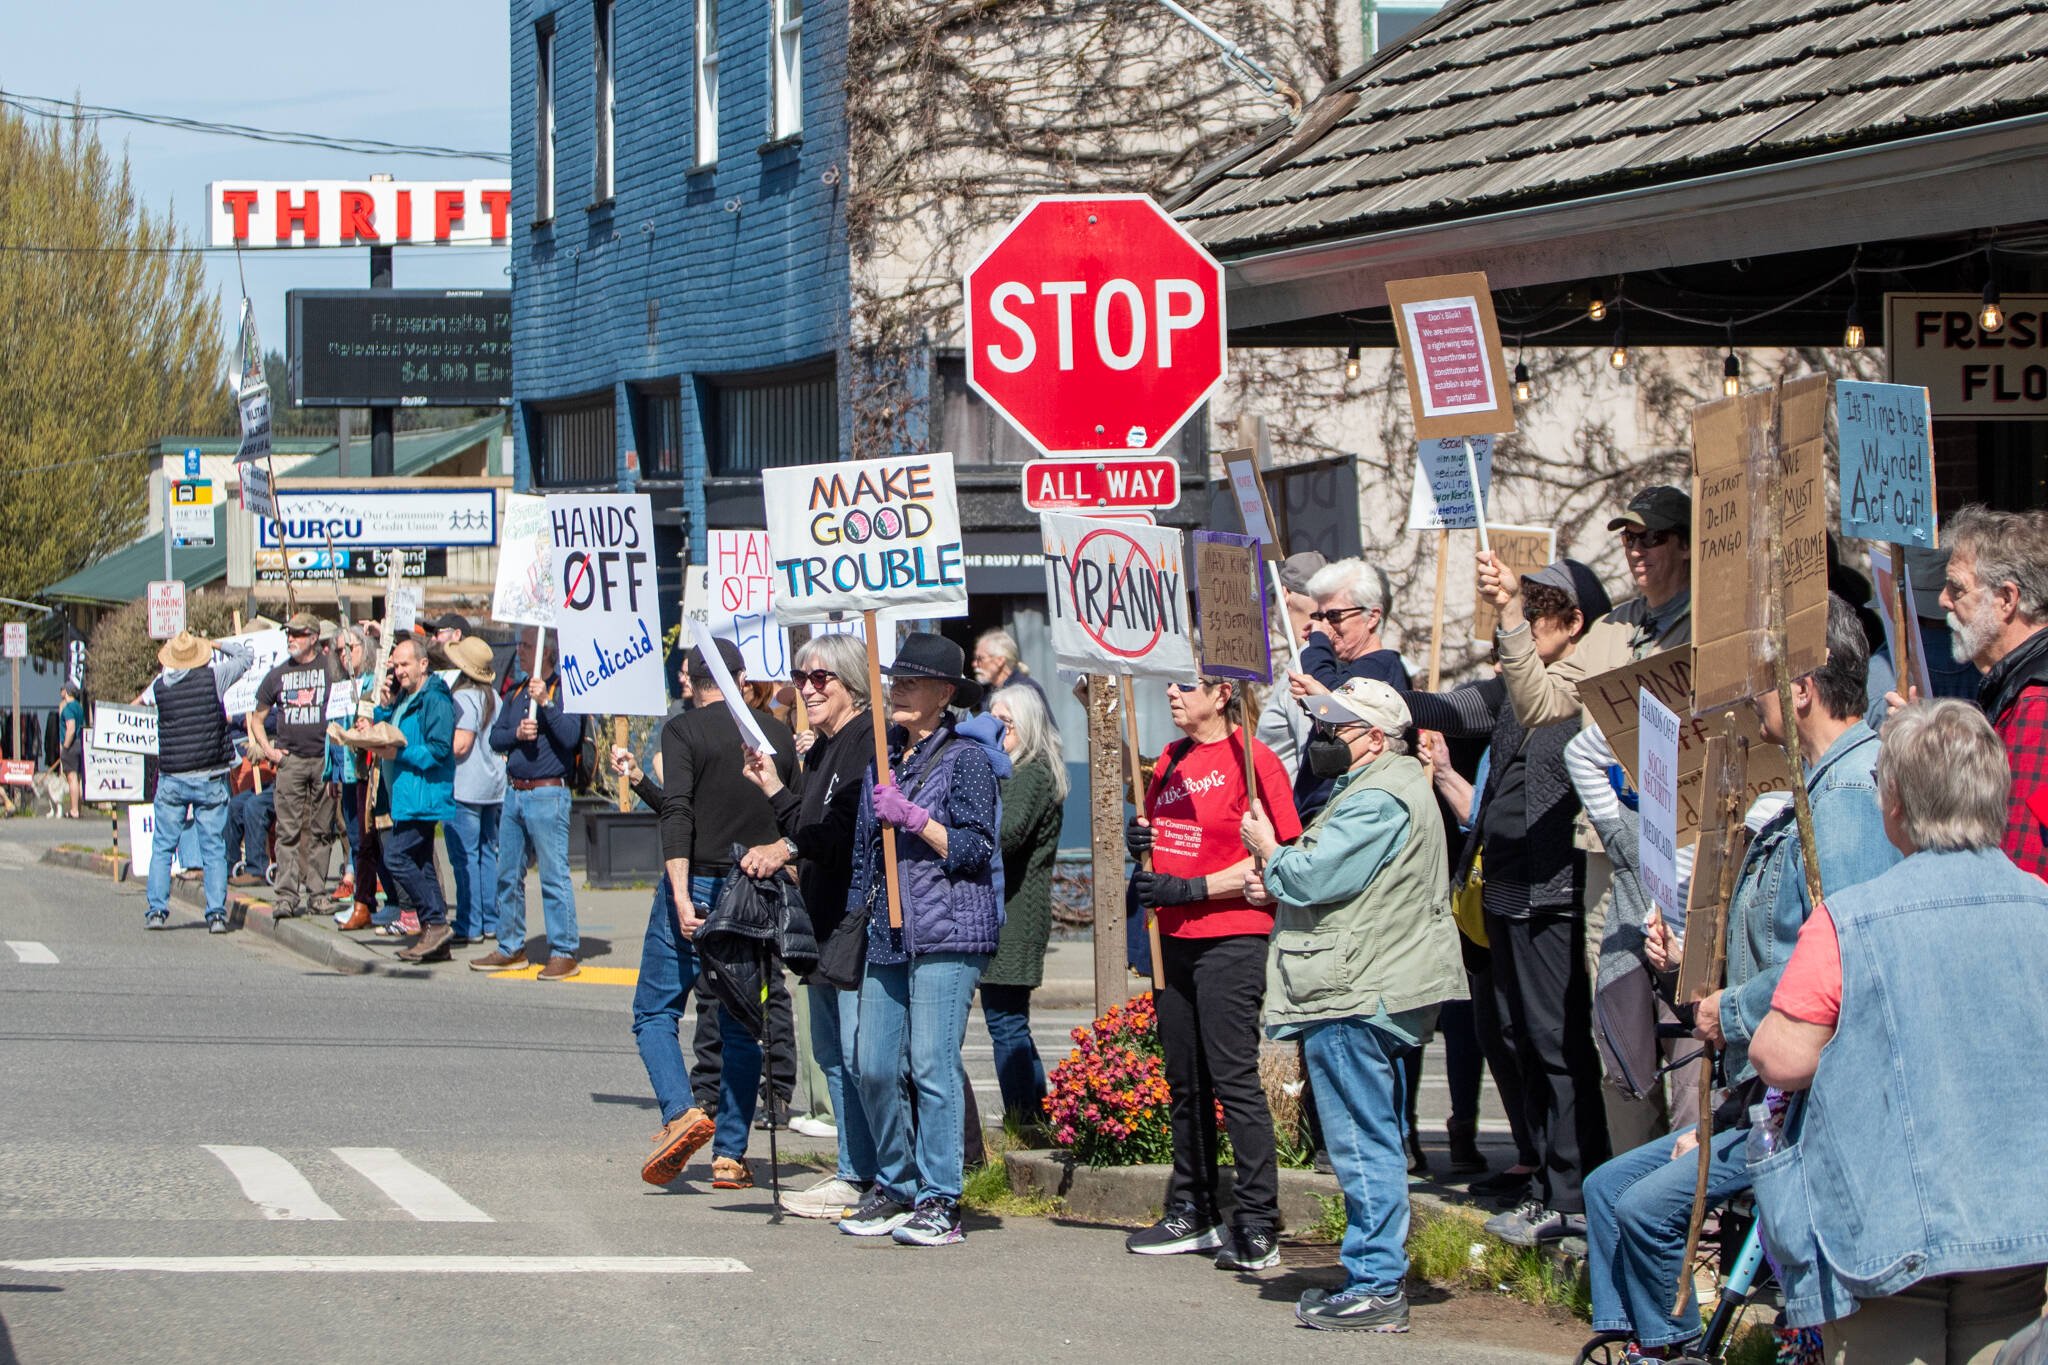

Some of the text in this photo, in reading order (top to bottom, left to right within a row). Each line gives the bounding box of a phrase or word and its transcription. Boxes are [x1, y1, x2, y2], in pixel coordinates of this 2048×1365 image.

[987, 278, 1205, 373] STOP
[1423, 328, 1433, 336] We
[1433, 328, 1444, 336] are
[1428, 313, 1444, 321] Don't
[1915, 311, 2048, 350] FRES
[1434, 365, 1479, 376] constitution and
[1437, 353, 1467, 362] overthrow
[1435, 380, 1460, 390] establish
[1446, 394, 1461, 404] party
[1962, 364, 2048, 403] FLO
[1862, 393, 1895, 436] Time
[1897, 396, 1908, 433] to
[1911, 398, 1924, 437] be
[1440, 438, 1464, 449] Social
[1861, 438, 1922, 486] Wyrde!
[1783, 450, 1800, 477] WE
[809, 464, 935, 510] MAKE
[1039, 469, 1164, 500] ALL WAY
[1783, 478, 1814, 515] MUST
[1851, 468, 1924, 527] Act Out!
[268, 510, 445, 539] OURCU Our Community
[373, 522, 438, 531] Credit Union
[551, 506, 640, 548] HANDS
[811, 502, 935, 546] GOOD
[983, 555, 1021, 566] RUBY
[1490, 533, 1548, 568] RMERS
[1701, 531, 1742, 562] TANGO
[1783, 531, 1824, 568] VERCOME
[563, 551, 647, 612] OFF
[776, 542, 963, 598] TROUBLE
[161, 588, 171, 597] NO
[1045, 553, 1178, 634] TYRANNY
[562, 618, 654, 697] Medicaid
[284, 706, 321, 724] YEAH
[1642, 696, 1676, 745] HANDS OFF!
[104, 732, 157, 746] TRUMP
[99, 778, 133, 790] ALL
[1182, 770, 1226, 798] People
[1648, 749, 1668, 787] SOCIAL
[1644, 770, 1672, 814] SECURITY
[1643, 815, 1672, 861] MEDICAID
[1643, 862, 1674, 911] MEDICARE
